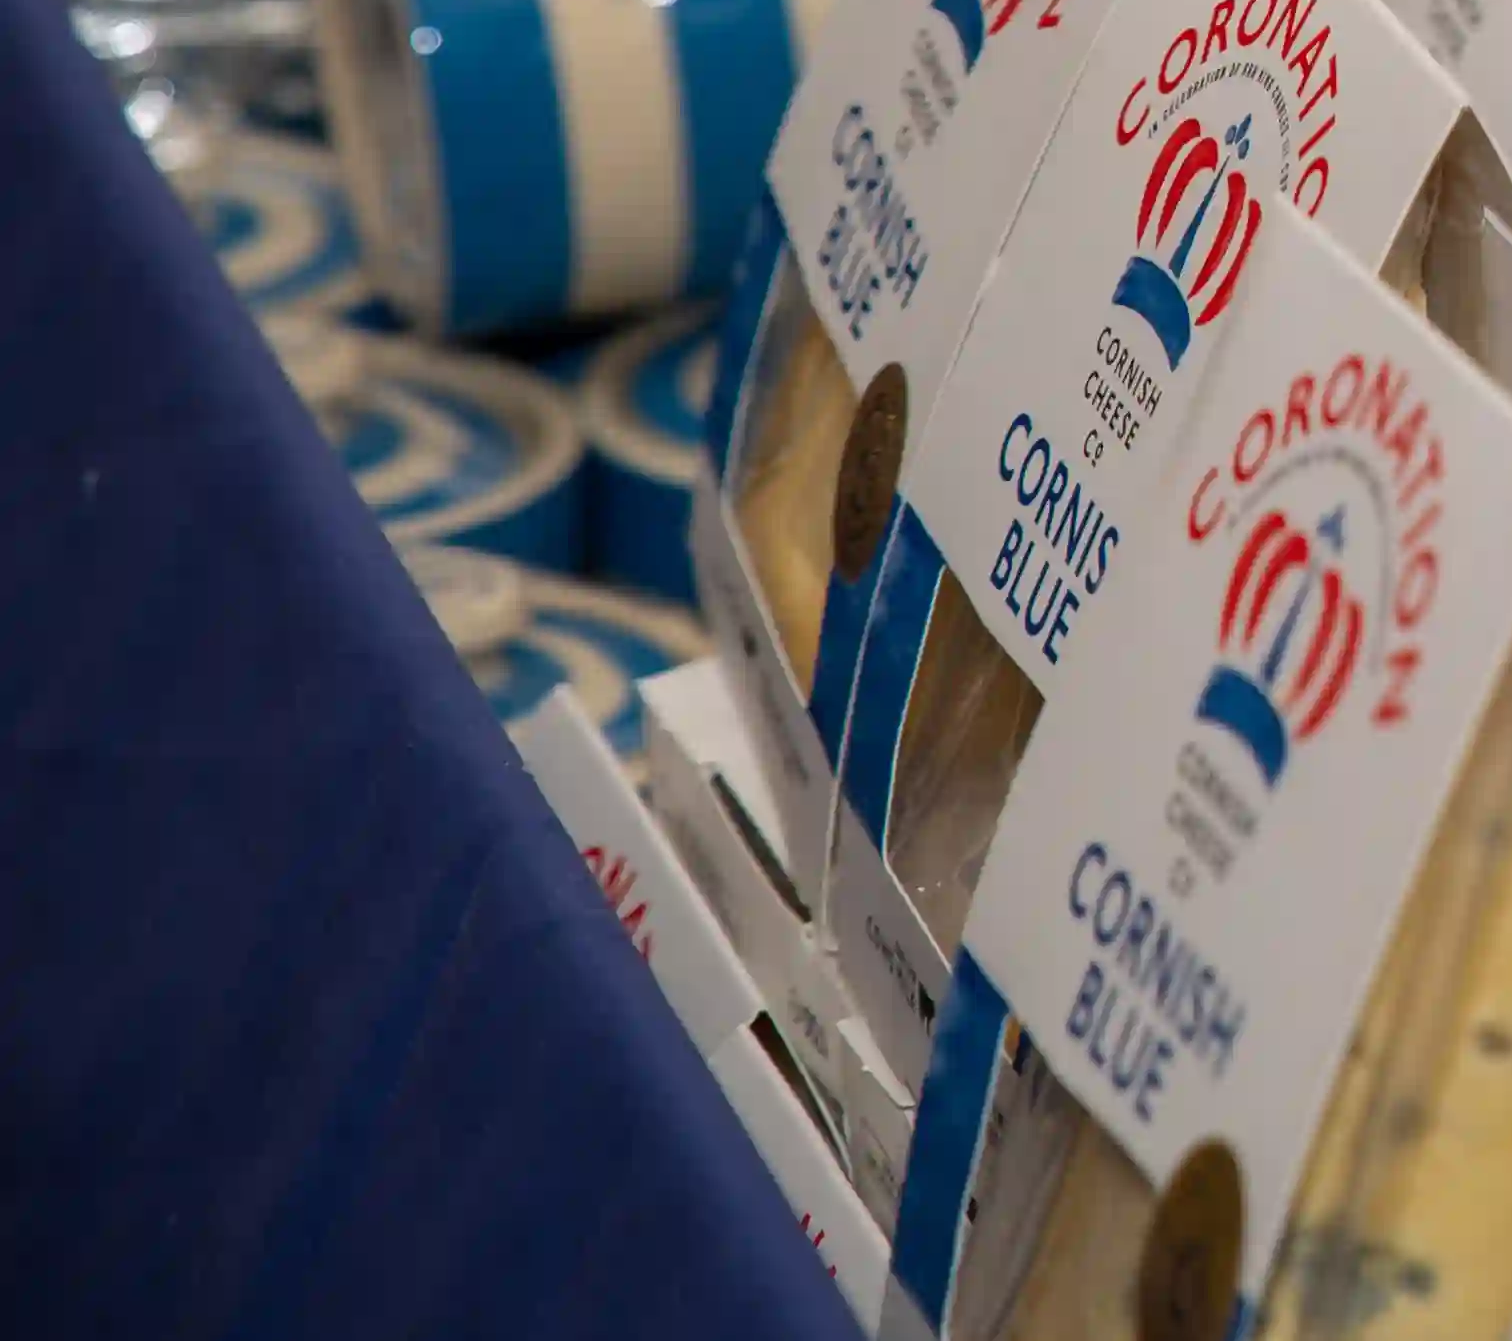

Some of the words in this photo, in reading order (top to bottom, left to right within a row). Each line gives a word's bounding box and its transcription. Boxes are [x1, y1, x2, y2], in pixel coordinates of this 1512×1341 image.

[1084, 370, 1140, 450] CHEESE
[1097, 326, 1163, 419] CORNISH
[990, 517, 1080, 665] BLUE
[1186, 353, 1447, 727] CORONATION
[1069, 841, 1247, 1081] CORNISH
[1066, 959, 1175, 1123] BLUE
